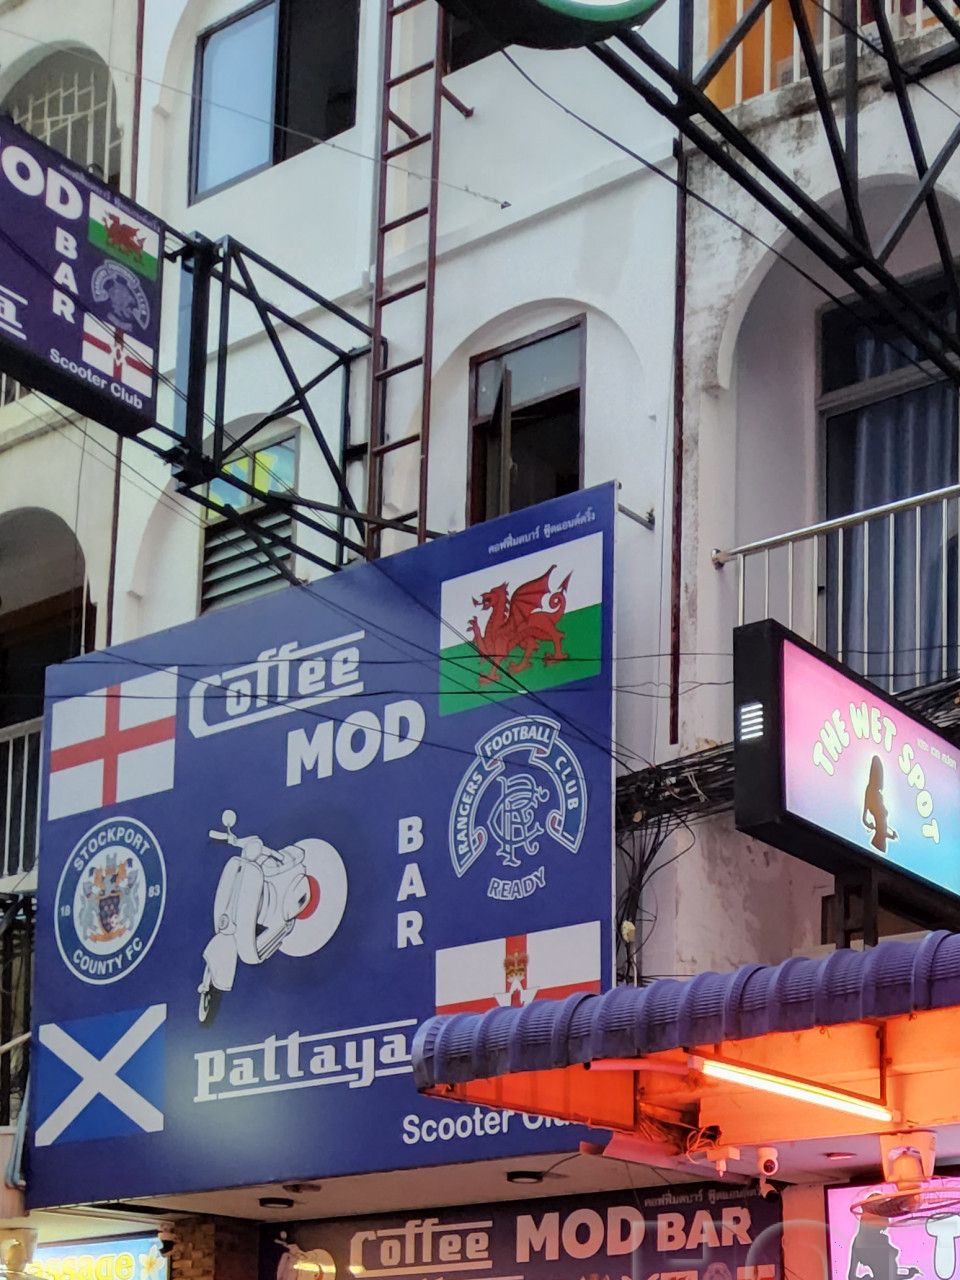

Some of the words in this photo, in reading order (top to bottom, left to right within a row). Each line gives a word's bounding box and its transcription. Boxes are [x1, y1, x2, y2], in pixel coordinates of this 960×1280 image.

[0, 146, 83, 220] OD
[52, 226, 78, 324] BAR
[50, 348, 107, 392] Scooter
[111, 377, 143, 410] Club
[189, 638, 365, 738] Coffee
[286, 700, 426, 787] MOD
[812, 709, 850, 776] THE
[849, 702, 896, 752] WET
[899, 743, 940, 844] SPOT
[456, 772, 483, 855] RANGERS
[484, 725, 549, 757] FOOTBALL
[555, 756, 579, 810] CLUB
[73, 827, 150, 871] STOCKPORT
[397, 815, 426, 949] BAR
[487, 866, 546, 900] READY
[61, 904, 70, 917] 18
[148, 884, 160, 897] 83
[73, 949, 122, 975] COUNTY
[126, 937, 143, 961] FC
[194, 1026, 414, 1102] Pattaya
[403, 1109, 514, 1144] Scooter
[350, 1217, 494, 1278] Coffee
[516, 1205, 646, 1262] MOD
[656, 1207, 753, 1251] BAR
